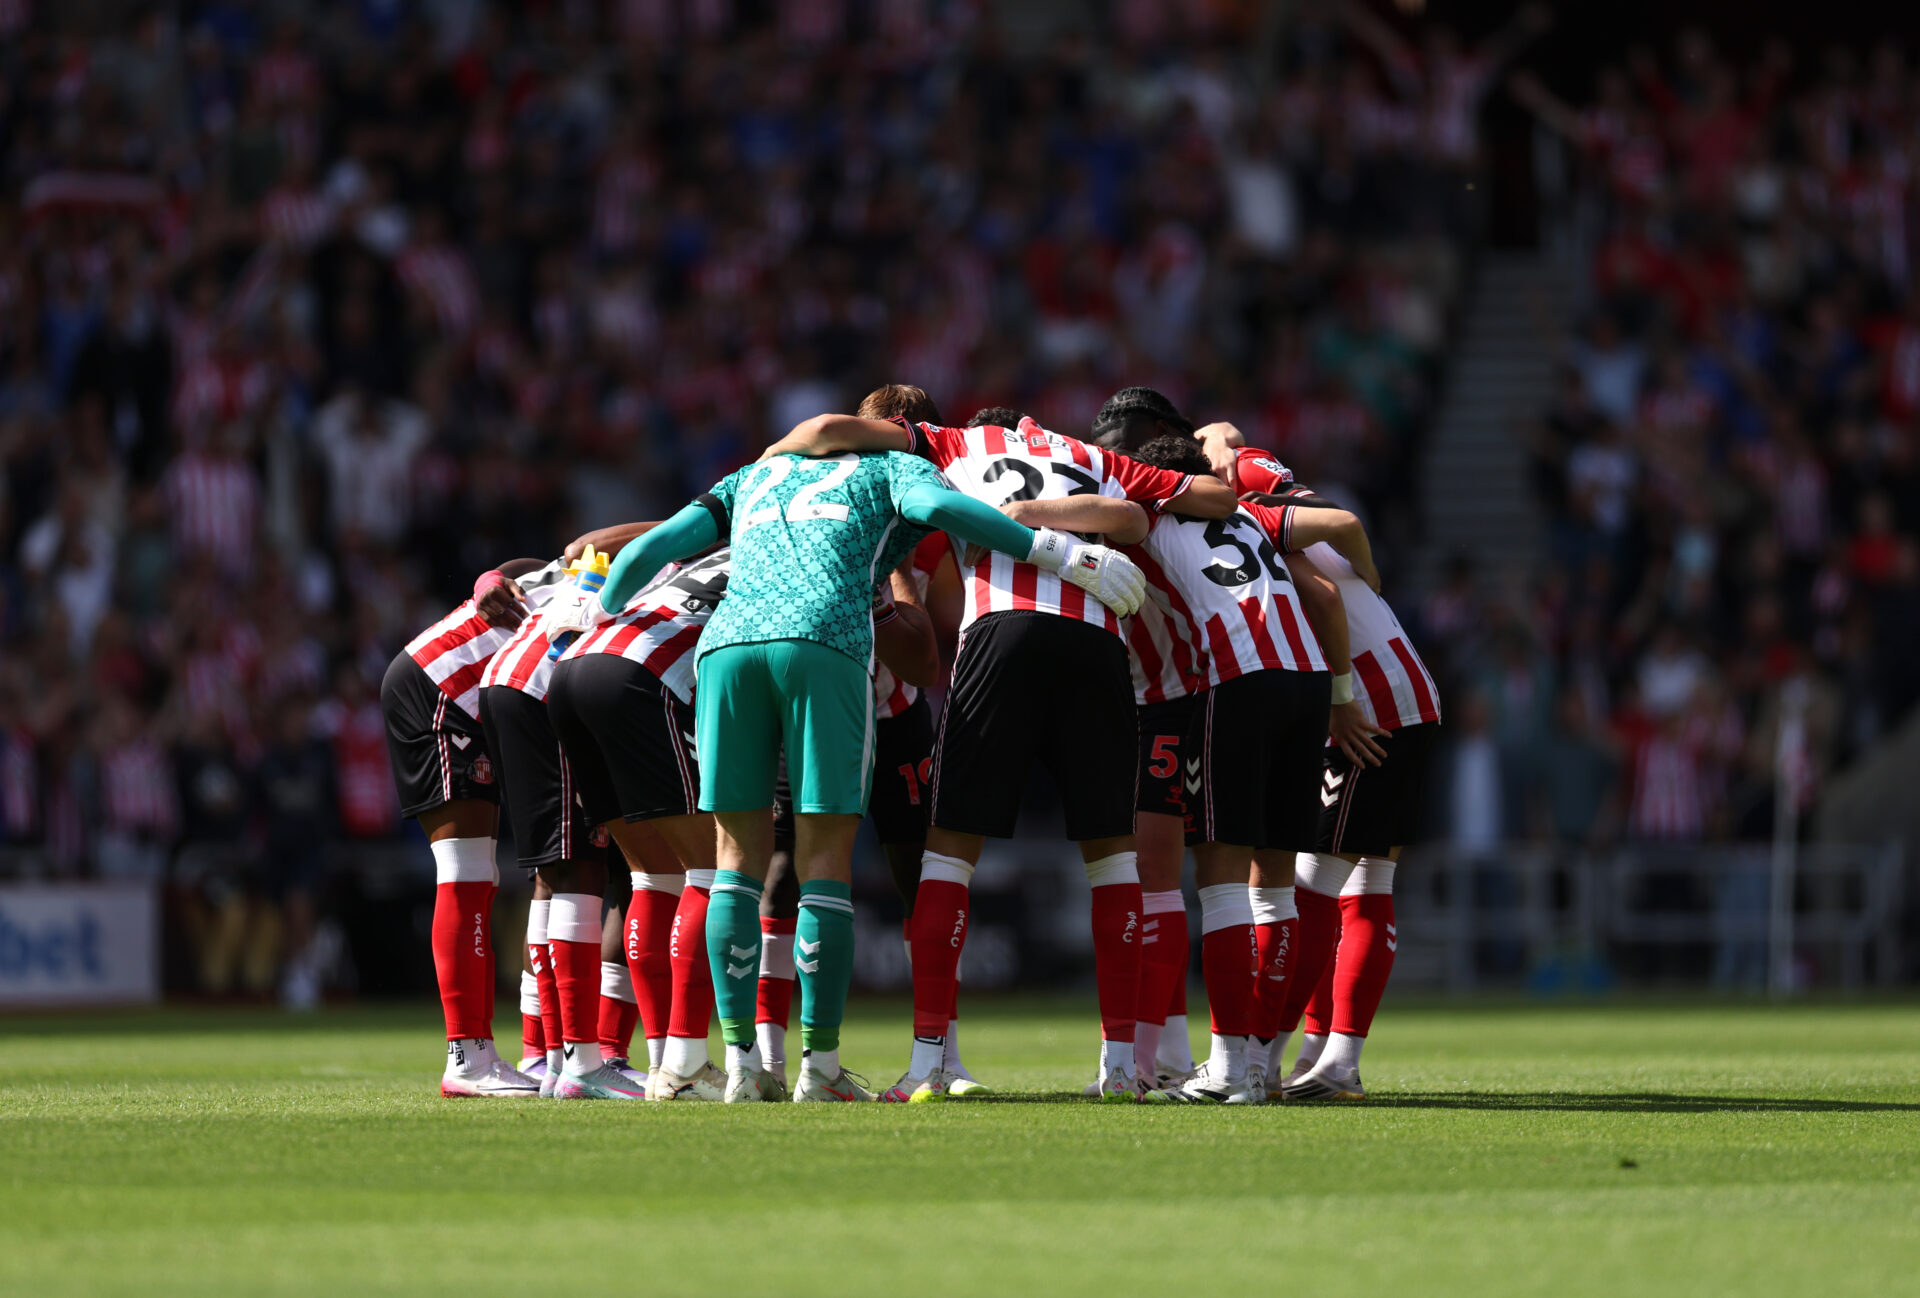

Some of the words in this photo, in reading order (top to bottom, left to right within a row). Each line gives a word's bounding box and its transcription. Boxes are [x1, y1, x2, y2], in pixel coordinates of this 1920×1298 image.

[736, 453, 860, 537] 22
[1148, 735, 1180, 778] 5
[474, 913, 485, 957] SAFC
[628, 918, 640, 960] SAFC
[671, 915, 682, 957] SAFC
[950, 909, 966, 948] SAFC
[1122, 911, 1137, 943] SAFC
[1248, 926, 1258, 957] AFC
[1274, 926, 1290, 968] SAFC
